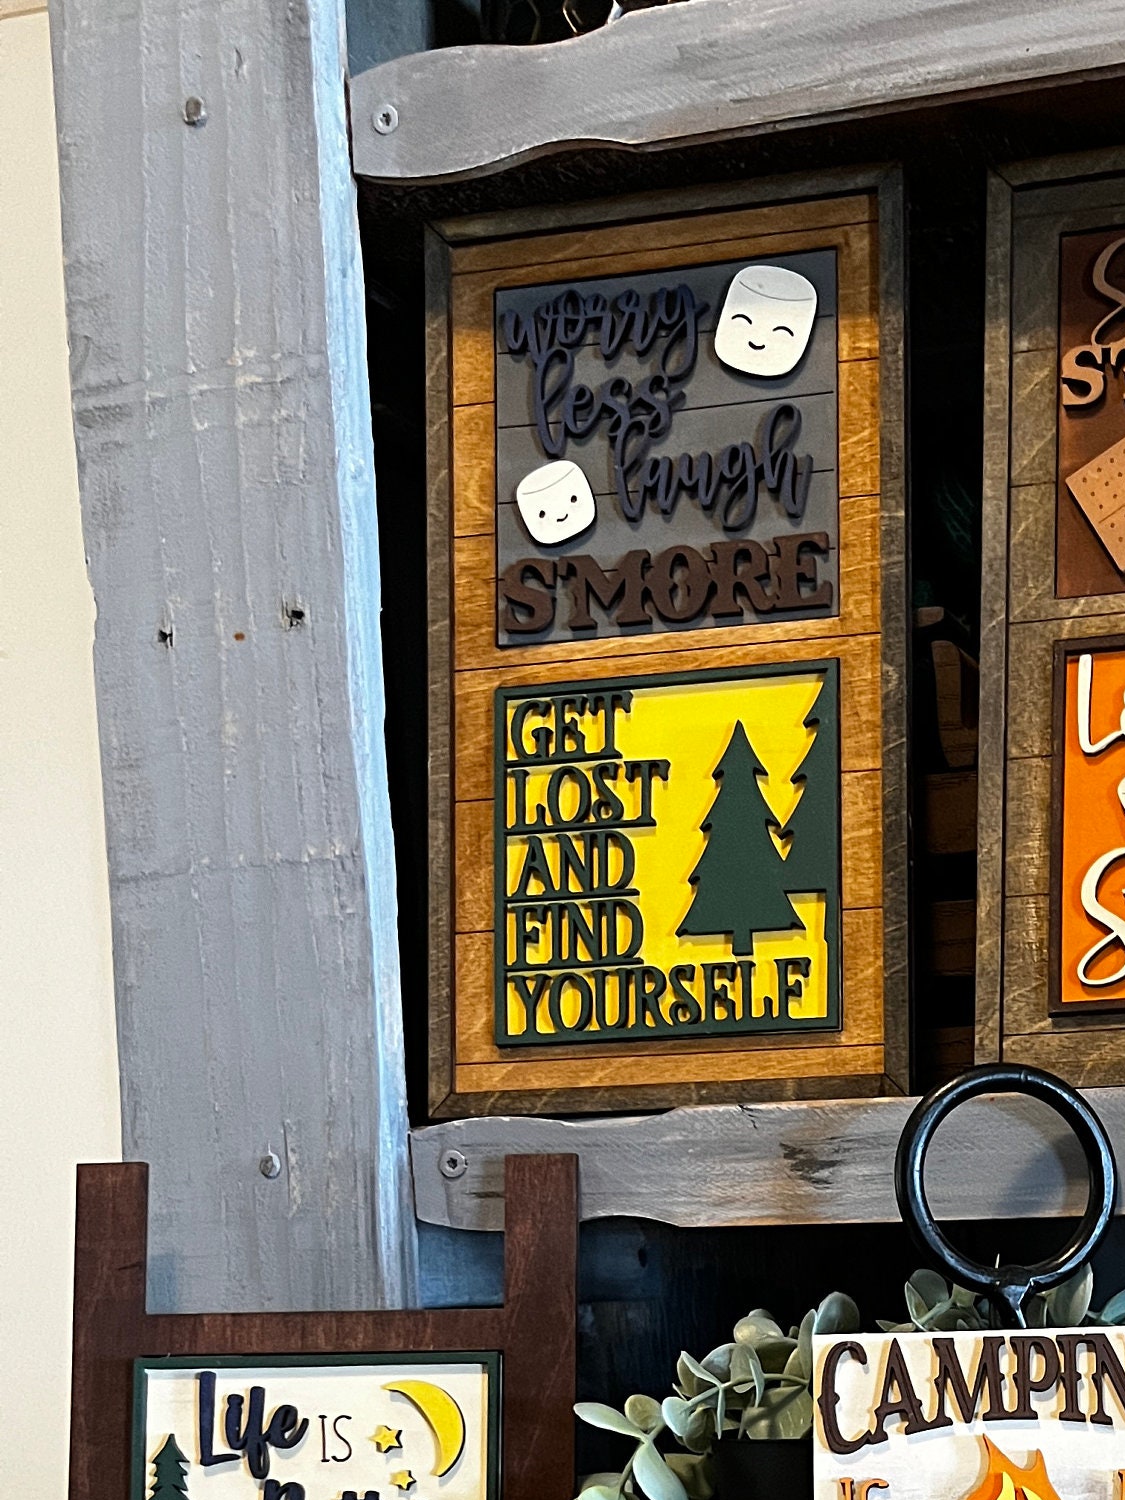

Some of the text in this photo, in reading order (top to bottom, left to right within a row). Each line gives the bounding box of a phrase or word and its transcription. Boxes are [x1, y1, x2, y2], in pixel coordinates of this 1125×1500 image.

[531, 348, 686, 459] less
[608, 404, 813, 532] laugh
[511, 690, 634, 762] GET
[508, 758, 670, 830] LOST
[508, 829, 640, 897] AND
[508, 898, 644, 966] FIND
[508, 956, 812, 1038] YOURSELF
[199, 1371, 352, 1479] Life IS
